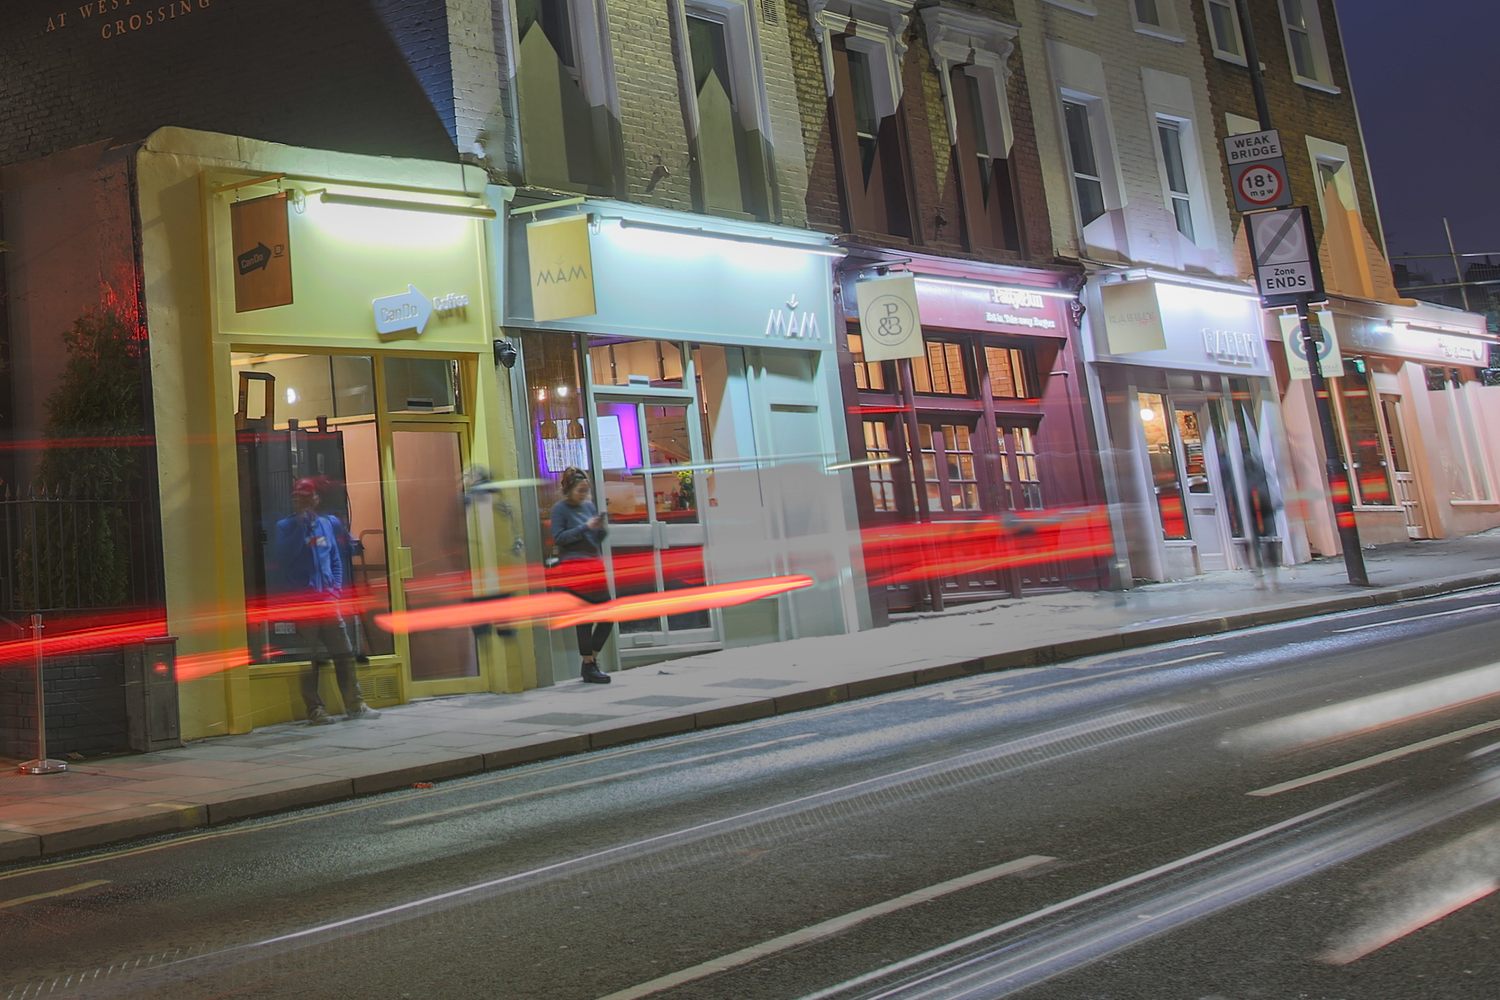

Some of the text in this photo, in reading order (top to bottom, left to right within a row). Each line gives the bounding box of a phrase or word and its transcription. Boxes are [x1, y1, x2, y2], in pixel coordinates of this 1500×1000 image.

[46, 12, 67, 32] AT
[1234, 135, 1270, 149] WEAK
[1231, 145, 1278, 160] BRIDGE
[536, 264, 587, 286] MAM
[1273, 268, 1295, 276] Zone
[1266, 275, 1307, 290] ENDS
[432, 293, 469, 311] Coffee
[765, 308, 822, 339] MAM
[1202, 328, 1259, 358] RABBIT
